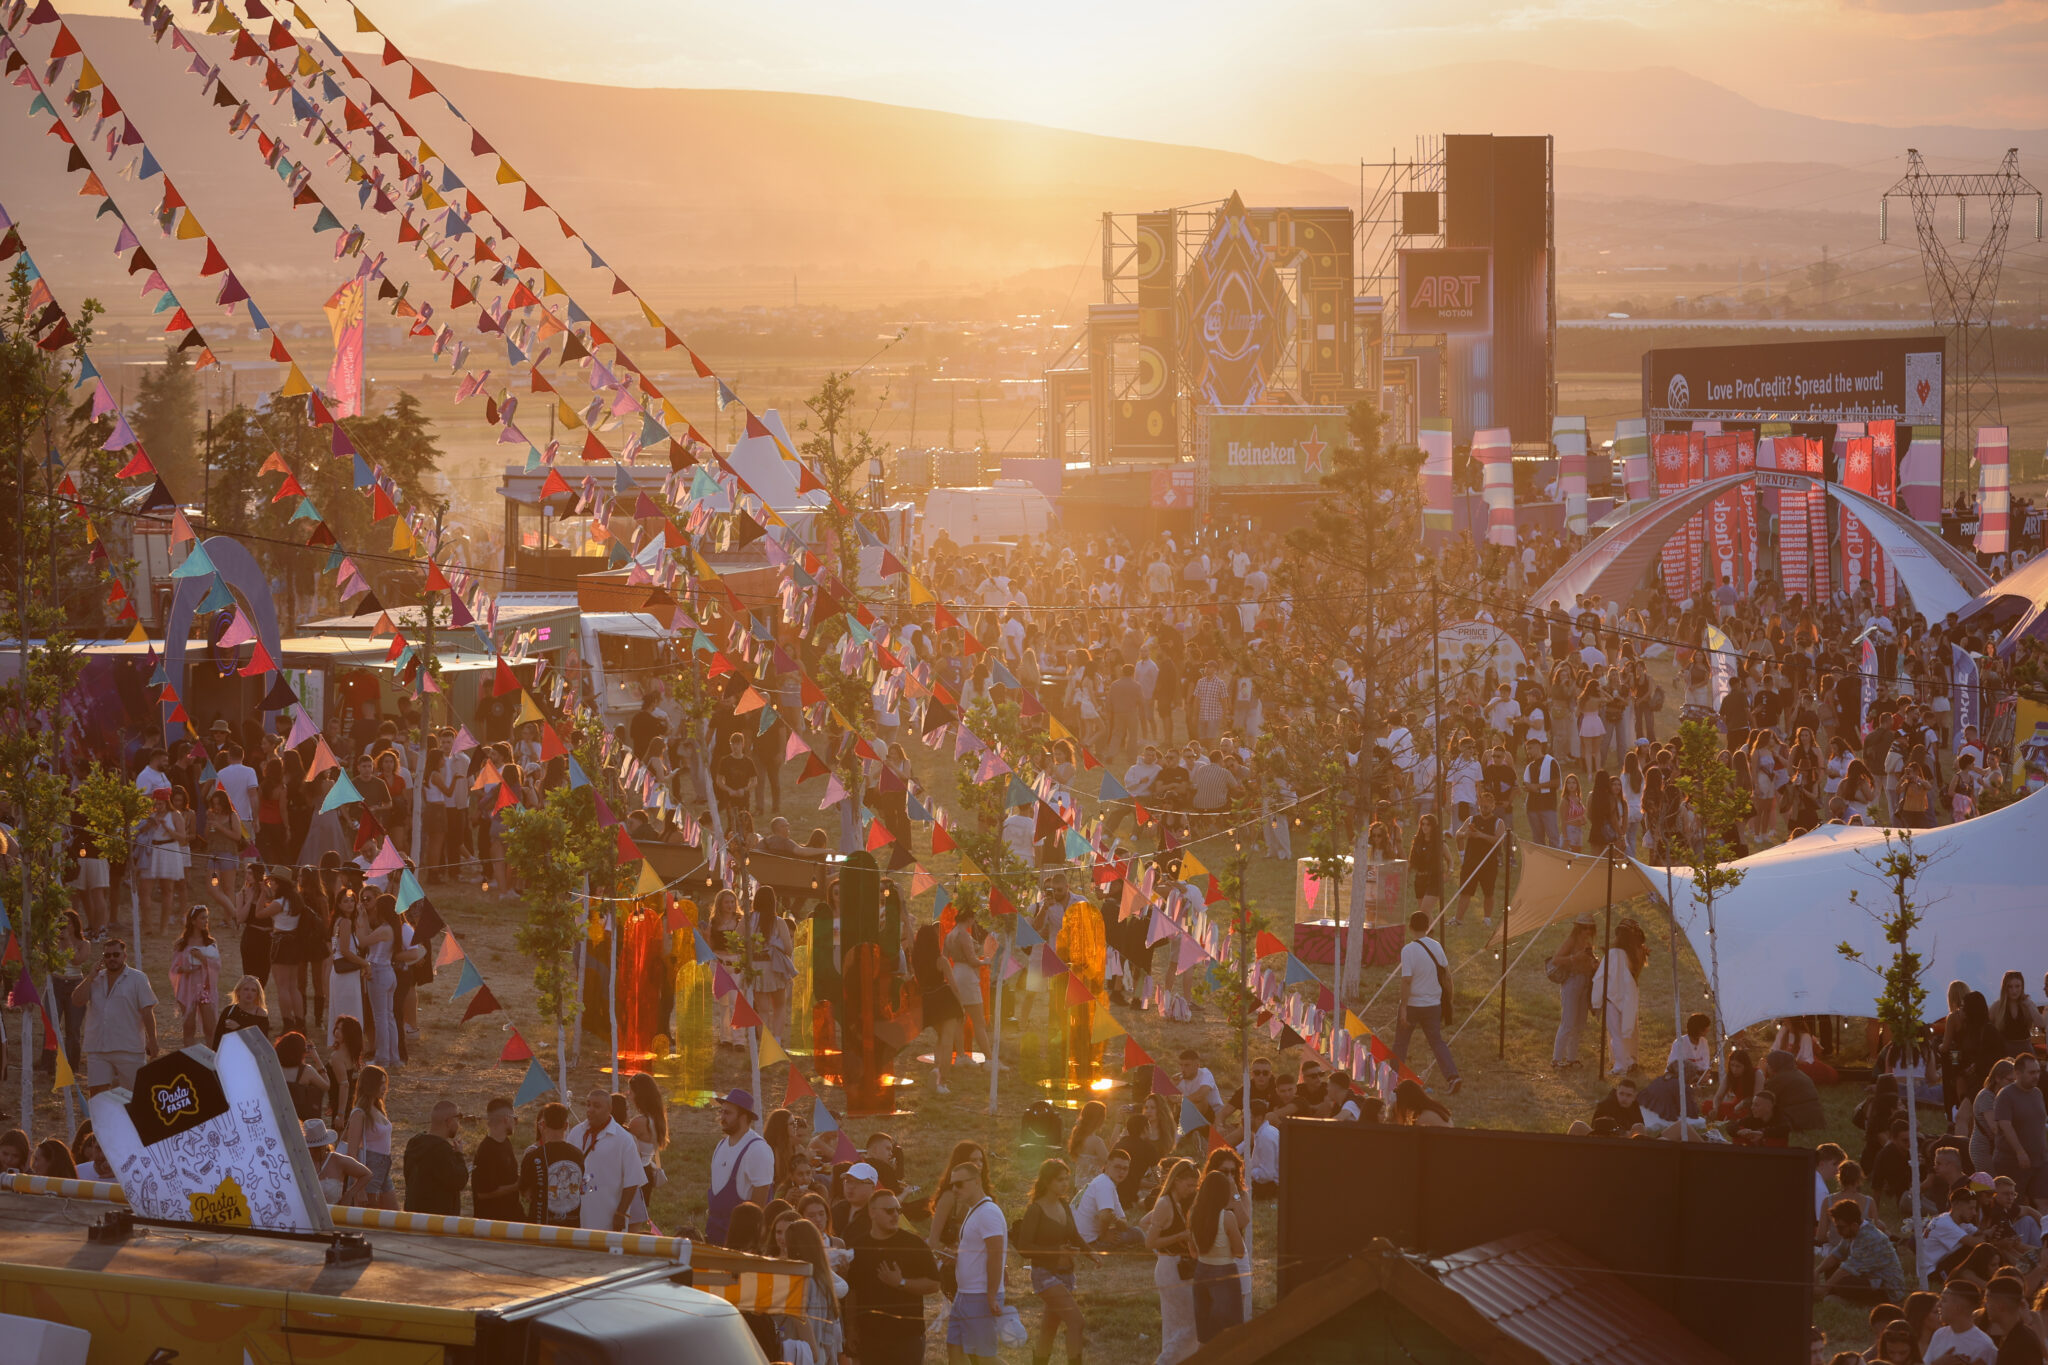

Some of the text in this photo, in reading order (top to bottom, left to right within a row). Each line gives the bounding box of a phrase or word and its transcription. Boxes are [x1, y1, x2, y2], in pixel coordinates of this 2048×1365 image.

[1410, 275, 1480, 308] ART
[1438, 309, 1473, 318] MOTION
[1707, 370, 1883, 400] Love ProCredit? Spread the word!
[1227, 440, 1297, 466] Heineken
[1458, 628, 1489, 636] PRINCE
[158, 1085, 190, 1110] Pasta
[167, 1097, 191, 1114] FASTA
[194, 1192, 237, 1221] Pasta
[204, 1206, 242, 1224] FASTA
